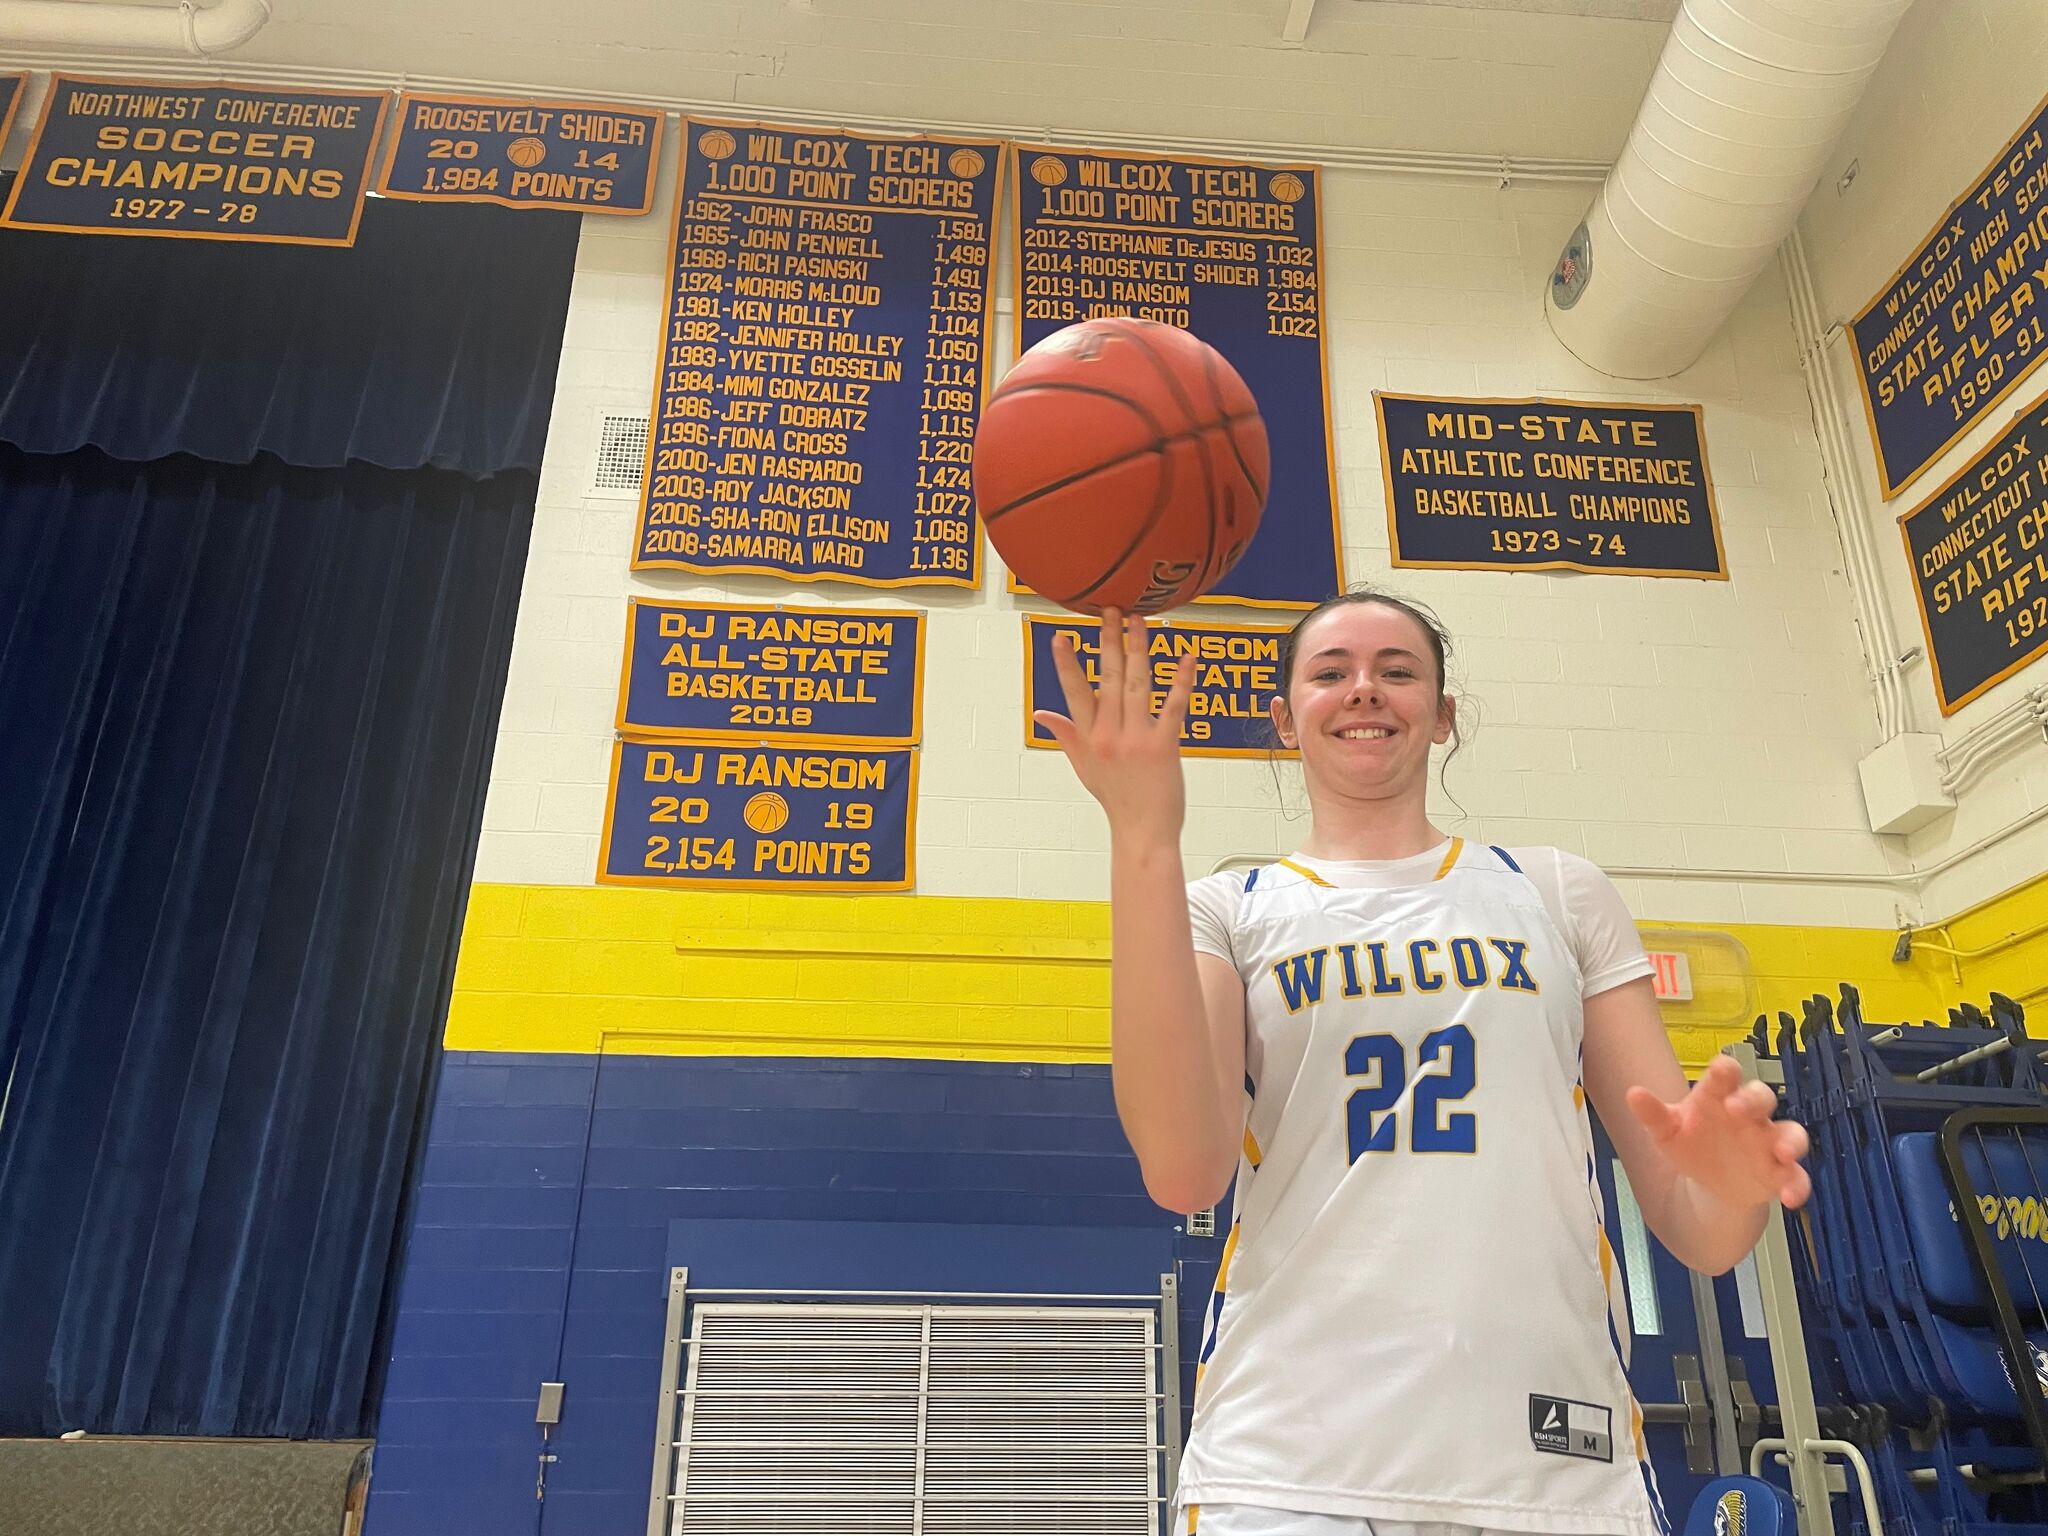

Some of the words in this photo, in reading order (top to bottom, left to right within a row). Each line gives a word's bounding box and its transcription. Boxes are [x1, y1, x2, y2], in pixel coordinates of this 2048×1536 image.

[67, 93, 204, 121] NORTHWEST
[215, 97, 359, 129] CONFERENCE
[415, 105, 553, 135] ROOSEVELT
[559, 113, 645, 145] SHIDER
[95, 125, 316, 160] SOCCER
[428, 138, 479, 161] 20
[576, 149, 618, 171] 14
[747, 135, 849, 169] WILCOX
[867, 143, 940, 176] TECH
[44, 156, 345, 199] CHAMPIONS
[423, 166, 499, 193] 1,984
[511, 171, 613, 201] POINTS
[707, 162, 777, 195] 1,000
[788, 168, 856, 201] POINT
[867, 175, 974, 209] SCORERS
[1078, 159, 1173, 193] WILCOX
[1184, 168, 1258, 199] TECH
[686, 199, 794, 228] 1962-JOHN
[799, 209, 873, 235] FRASCO
[937, 219, 985, 242] 1,581
[1041, 187, 1105, 218] 1,000
[1114, 191, 1181, 225] POINT
[1192, 199, 1295, 232] SCORERS
[1884, 216, 1965, 318] WILCOX
[1976, 130, 2043, 211] TECH
[683, 224, 790, 251] 1965-JOHN
[796, 232, 881, 259] PENWELL
[935, 242, 987, 267] 1,498
[1023, 227, 1174, 257] 2012-STEPHANIE
[1266, 243, 1313, 267] 1,032
[681, 248, 780, 275] 1968-RICH
[784, 255, 869, 280] PASINSKI
[932, 267, 982, 290] 1,491
[1024, 251, 1186, 282] 2014-ROOSEVELT
[1192, 262, 1260, 287] SHIDER
[1268, 269, 1317, 289] 1,984
[677, 271, 803, 301] 1974-MORRIS
[807, 282, 881, 307] McLOUD
[931, 290, 983, 314] 1,153
[1025, 273, 1107, 300] 2019-DJ
[1111, 280, 1191, 306] RANSOM
[1266, 292, 1317, 313] 2,154
[1868, 256, 1964, 374] CONNECTICUT
[1971, 209, 2009, 265] HIGH
[676, 295, 773, 323] 1981-KEN
[777, 303, 853, 329] HOLLEY
[928, 313, 979, 338] 1,104
[1025, 297, 1131, 321] 2019-JOHN
[1139, 306, 1189, 329] SOTO
[1268, 315, 1317, 339] 1,022
[672, 320, 824, 351] 1982-JENNIFER
[827, 332, 903, 357] HOLLEY
[927, 338, 979, 363] 1,050
[670, 345, 806, 376] 1983-YVETTE
[810, 354, 903, 383] GOSSELIN
[924, 363, 976, 389] 1,114
[1877, 324, 1945, 408] STATE
[1951, 316, 2044, 422] 1990-91
[667, 370, 764, 398] 1984-MIMI
[767, 377, 870, 407] GONZALEZ
[922, 388, 975, 413] 1,099
[664, 396, 773, 423] 1986-JEFF
[778, 403, 868, 432] DOBRATZ
[920, 413, 975, 439] 1,115
[1425, 412, 1659, 448] MID-STATE
[661, 421, 776, 451] 1996-FIONA
[783, 429, 848, 456] CROSS
[917, 439, 974, 464] 1,220
[656, 448, 757, 476] 2000-JEN
[761, 454, 863, 485] RASPARDO
[916, 465, 973, 490] 1,474
[1400, 447, 1526, 479] ATHLETIC
[1532, 451, 1697, 488] CONFERENCE
[1941, 435, 2031, 524] WILCOX
[652, 474, 753, 503] 2003-ROY
[758, 482, 852, 511] JACKSON
[915, 491, 972, 517] 1,077
[1413, 486, 1558, 520] BASKETBALL
[1568, 493, 1692, 526] CHAMPIONS
[648, 501, 802, 537] 2006-SHA-RON
[805, 513, 891, 544] ELLISON
[911, 518, 969, 545] 1,068
[1922, 471, 2031, 578] CONNECTICUT
[645, 528, 805, 565] 2008-SAMARRA
[811, 540, 865, 569] WARD
[911, 545, 969, 572] 1,136
[1933, 533, 2012, 613] STATE
[658, 612, 716, 640] DJ
[727, 615, 894, 647] RANSOM
[1122, 633, 1278, 662] ANSOM
[660, 642, 890, 676] ALL-STATE
[666, 671, 877, 704] BASKETBALL
[729, 703, 813, 727] 2018
[643, 750, 705, 785] DJ
[716, 752, 888, 791] RANSOM
[648, 795, 710, 825] 20
[824, 801, 874, 831] 19
[643, 834, 737, 873] 2,154
[753, 838, 872, 876] POINTS
[1271, 935, 1540, 1015] WILCOX
[1343, 1022, 1478, 1169] 22
[1583, 1435, 1597, 1451] M
